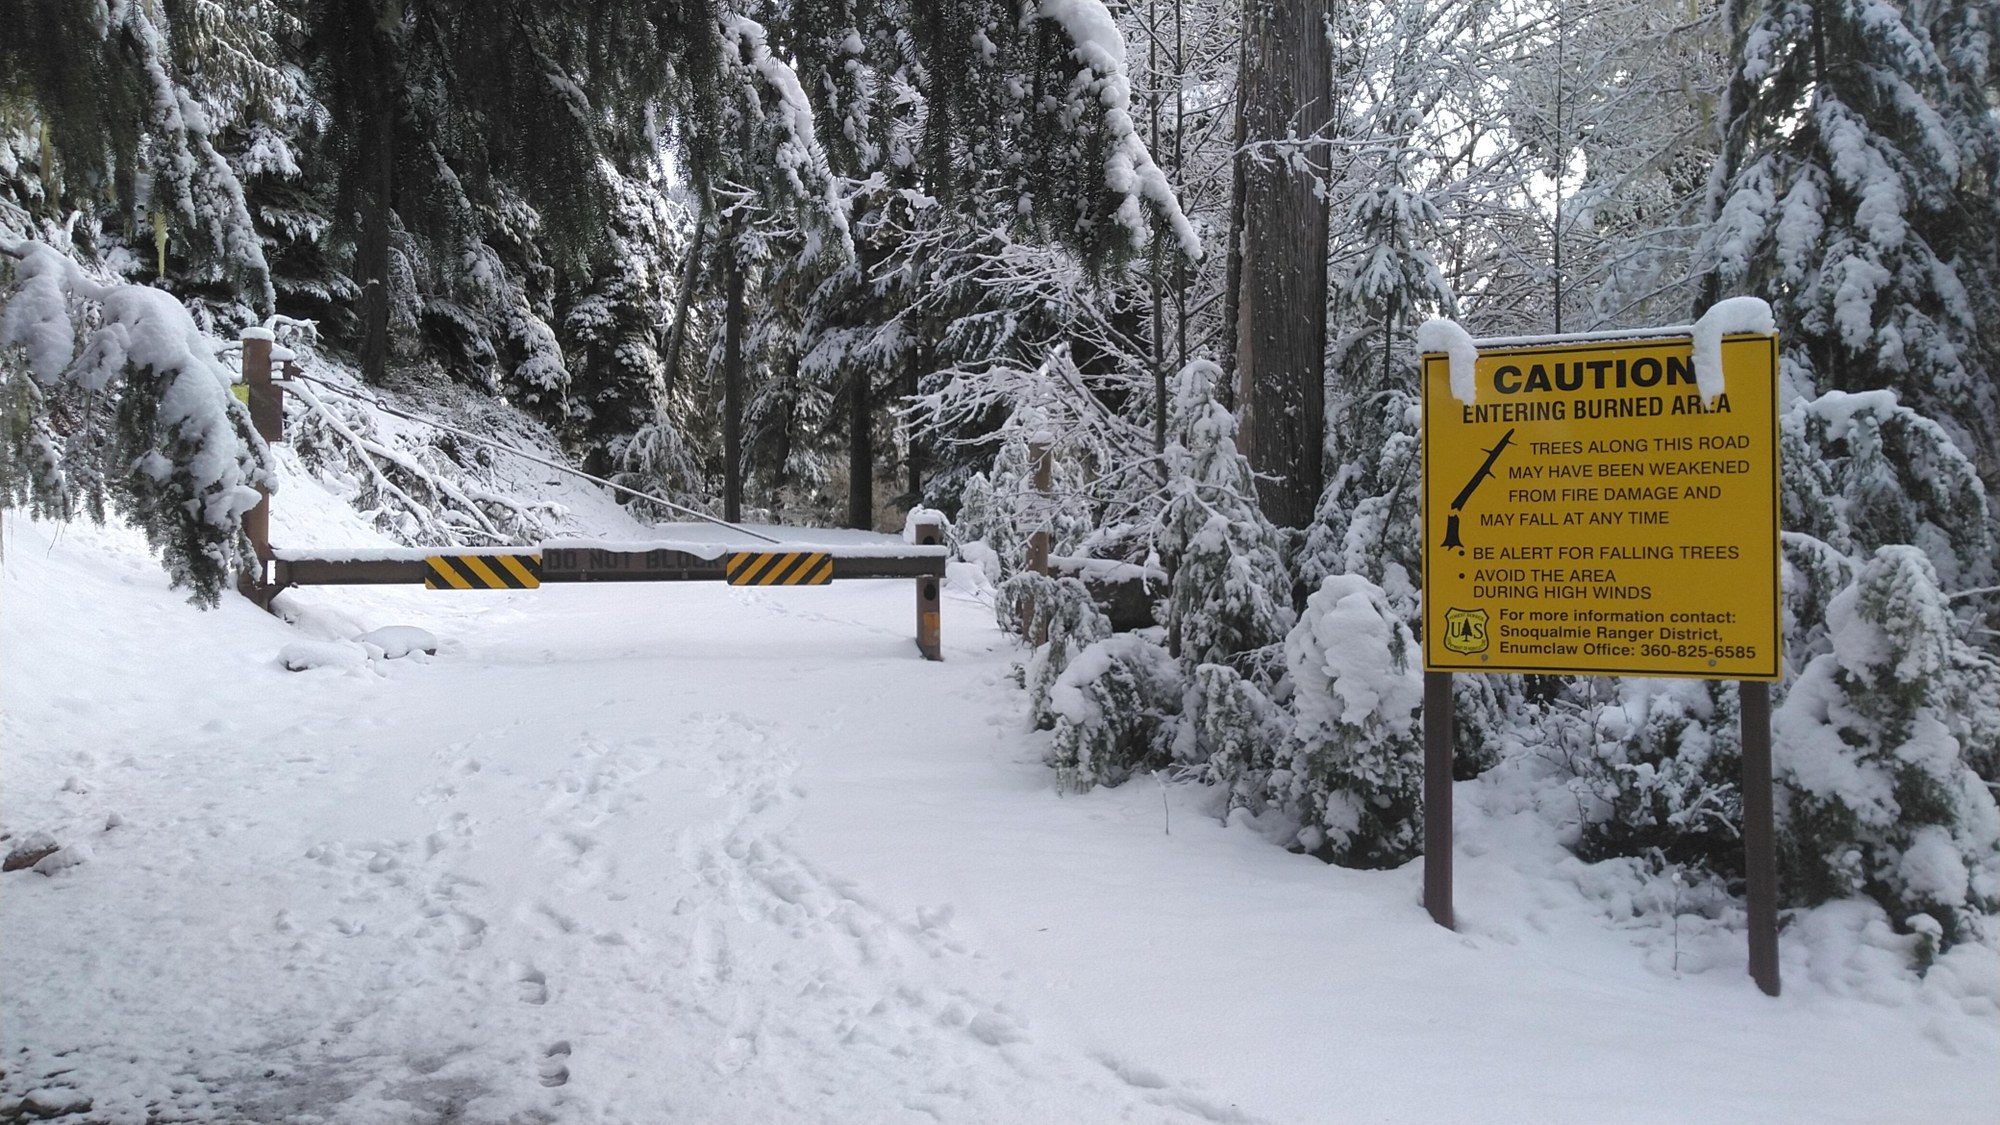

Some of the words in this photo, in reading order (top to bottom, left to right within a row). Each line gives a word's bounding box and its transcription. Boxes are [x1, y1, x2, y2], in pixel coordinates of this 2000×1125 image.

[1493, 356, 1696, 394] CAUTION
[1463, 401, 1565, 424] ENTERING
[1575, 398, 1663, 420] BURNED
[1530, 441, 1583, 455] TREES
[1588, 439, 1648, 453] ALONG
[1653, 437, 1693, 451] THIS
[1699, 435, 1749, 450] ROAD
[1509, 466, 1543, 479] MAY
[1550, 465, 1592, 478] HAVE
[1599, 463, 1644, 477] BEEN
[1649, 461, 1749, 475] WEAKENED
[1509, 489, 1556, 503] FROM
[1562, 488, 1598, 501] FIRE
[1604, 486, 1678, 501] DAMAGE
[1684, 486, 1721, 499] AND
[1480, 513, 1515, 526] MAY
[1520, 512, 1558, 526] FALL
[1564, 512, 1584, 525] AT
[1589, 512, 1623, 525] ANY
[1628, 511, 1669, 524] TIME
[549, 551, 577, 570] DO
[590, 550, 630, 569] NOT
[1473, 547, 1494, 560] BE
[1500, 547, 1554, 560] ALERT
[1559, 547, 1593, 559] FOR
[1600, 546, 1674, 559] FALLING
[1679, 545, 1739, 559] TREES
[1474, 569, 1525, 582] AVOID
[1531, 569, 1564, 582] THE
[1569, 569, 1616, 582] AREA
[1473, 586, 1538, 599] DURING
[1545, 586, 1587, 599] HIGH
[1593, 586, 1652, 599] WINDS
[1500, 608, 1524, 621] For
[1529, 612, 1569, 622] more
[1574, 609, 1664, 622] information
[1670, 611, 1736, 624] contact:
[1500, 625, 1591, 640] Snoqualmie
[1597, 626, 1654, 642] Ranger
[1660, 627, 1723, 642] District,
[1500, 642, 1578, 655] Enumclaw
[1583, 643, 1635, 656] Office:
[1640, 644, 1756, 659] 360-825-6585
